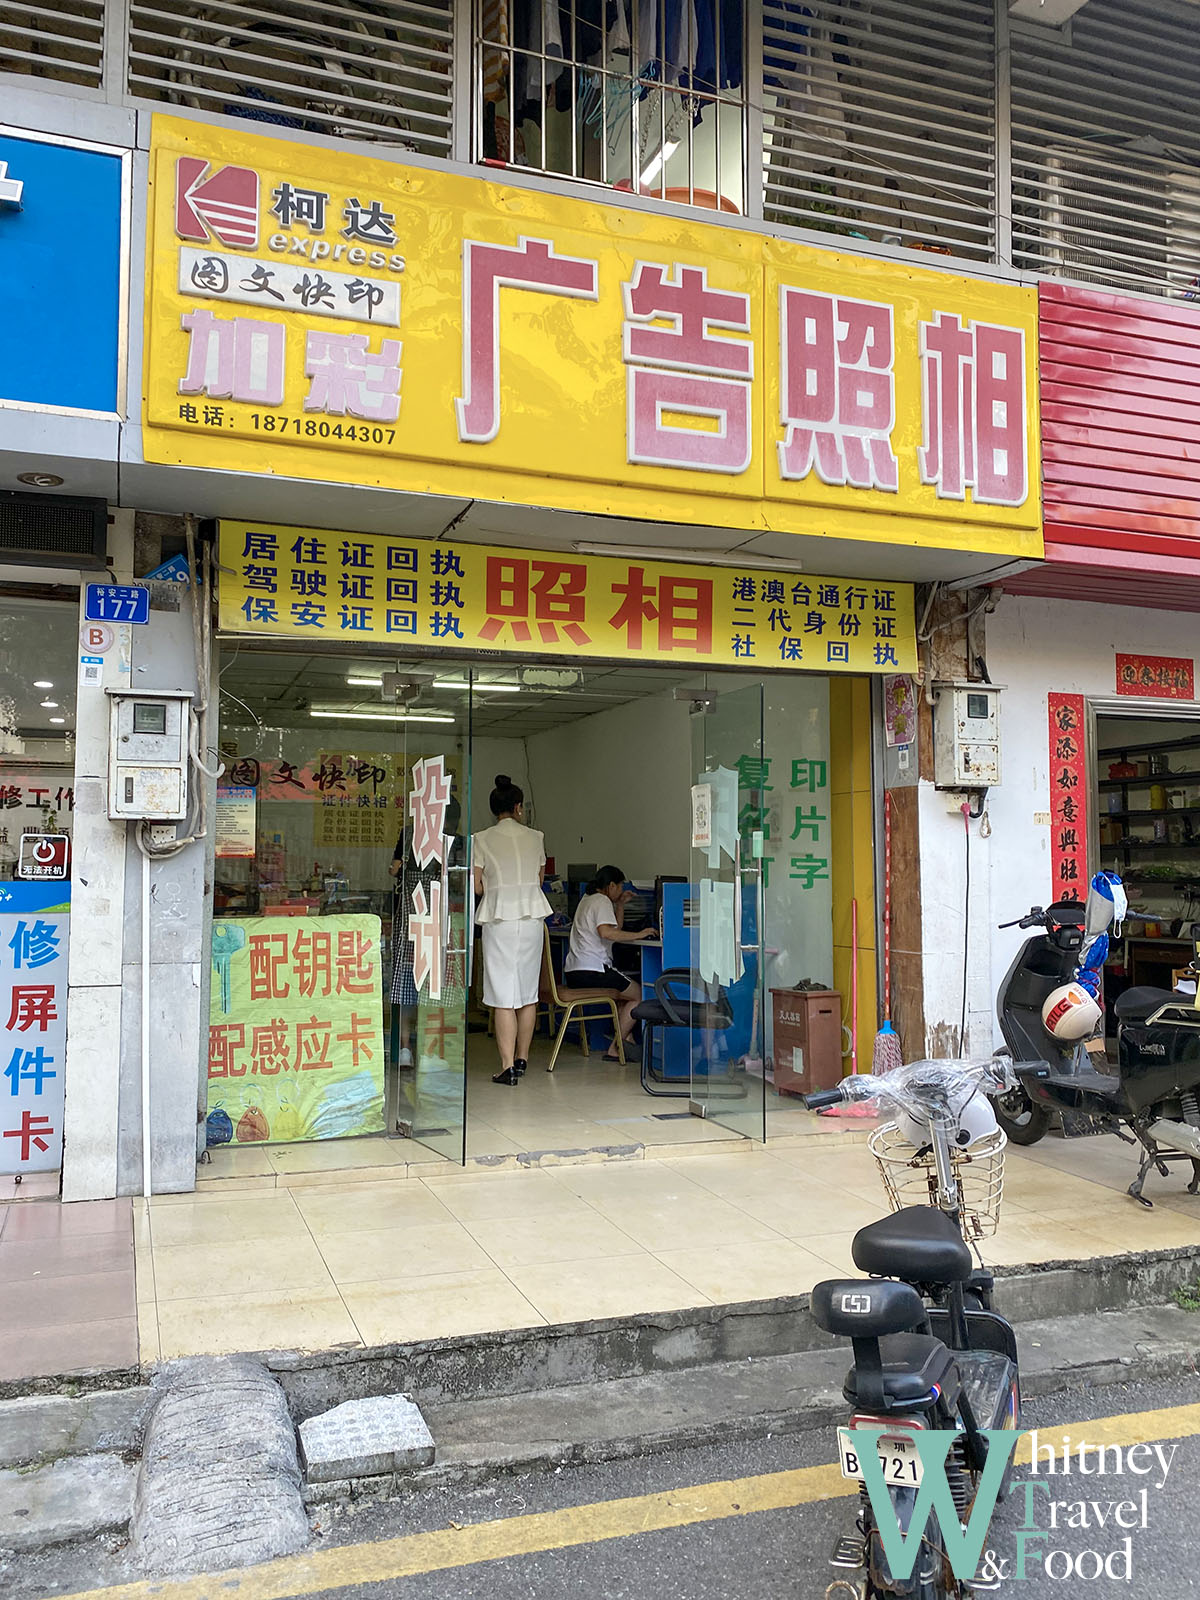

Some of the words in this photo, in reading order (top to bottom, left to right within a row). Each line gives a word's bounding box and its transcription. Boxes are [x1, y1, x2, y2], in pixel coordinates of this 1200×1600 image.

[272, 182, 399, 247] 柯达
[269, 230, 405, 273] express
[191, 257, 385, 319] 图文快印
[177, 308, 402, 424] 加彩
[454, 235, 1026, 507] 广告照相
[242, 532, 465, 579] 居住证回执
[96, 587, 139, 599] 裕安二路
[97, 597, 138, 619] 177
[242, 564, 465, 609] 驾驶证回执
[476, 555, 714, 655] 照相
[732, 576, 896, 612] 港澳台通行证
[89, 628, 104, 646] B
[242, 595, 465, 639] 保安证回执
[732, 607, 898, 639] 二代身份证
[731, 633, 899, 667] 社保回执
[231, 758, 386, 795] 图文快印
[23, 865, 63, 875] 无法开机
[249, 929, 375, 1000] 配钥匙
[208, 1012, 376, 1079] 配感应卡
